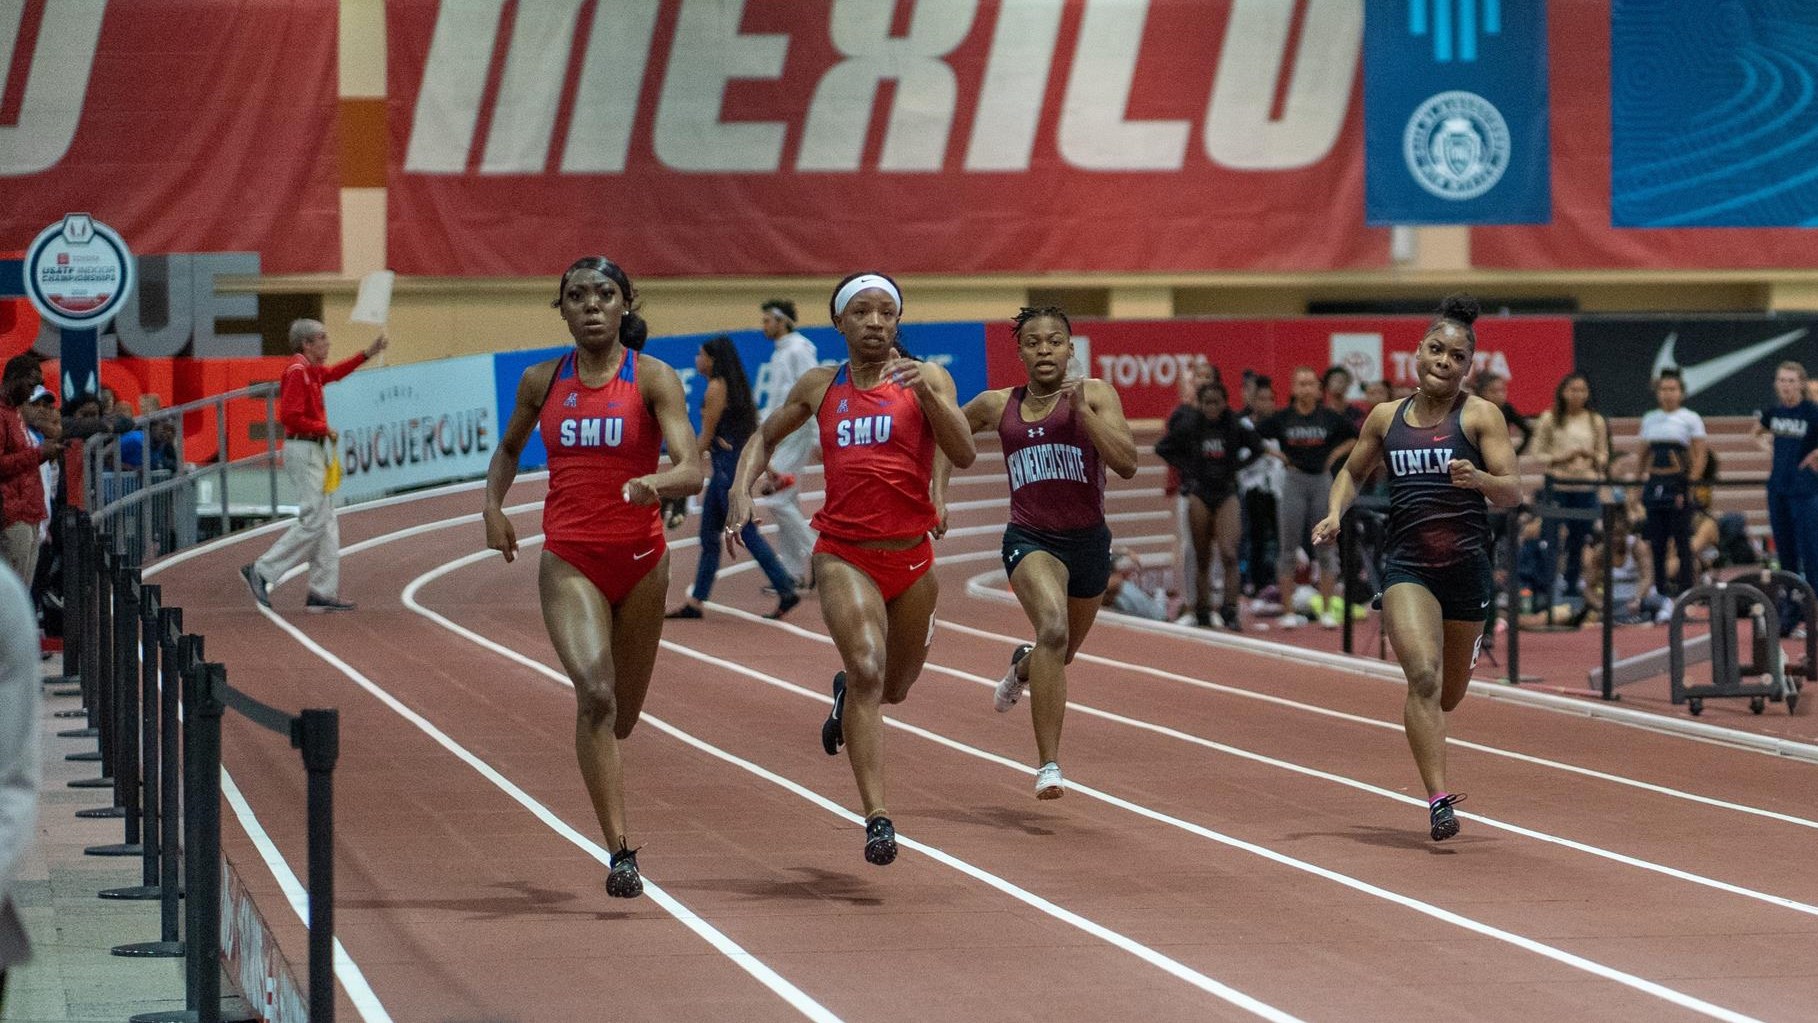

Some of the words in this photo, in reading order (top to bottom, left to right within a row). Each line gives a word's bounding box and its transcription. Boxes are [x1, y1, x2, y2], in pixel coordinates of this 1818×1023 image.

[344, 407, 488, 476] BUQUERQUE
[560, 418, 622, 447] SMU
[837, 415, 891, 447] SMU
[1020, 443, 1058, 484] MEXICO
[1053, 443, 1088, 484] STATE
[1390, 448, 1452, 477] UNLV
